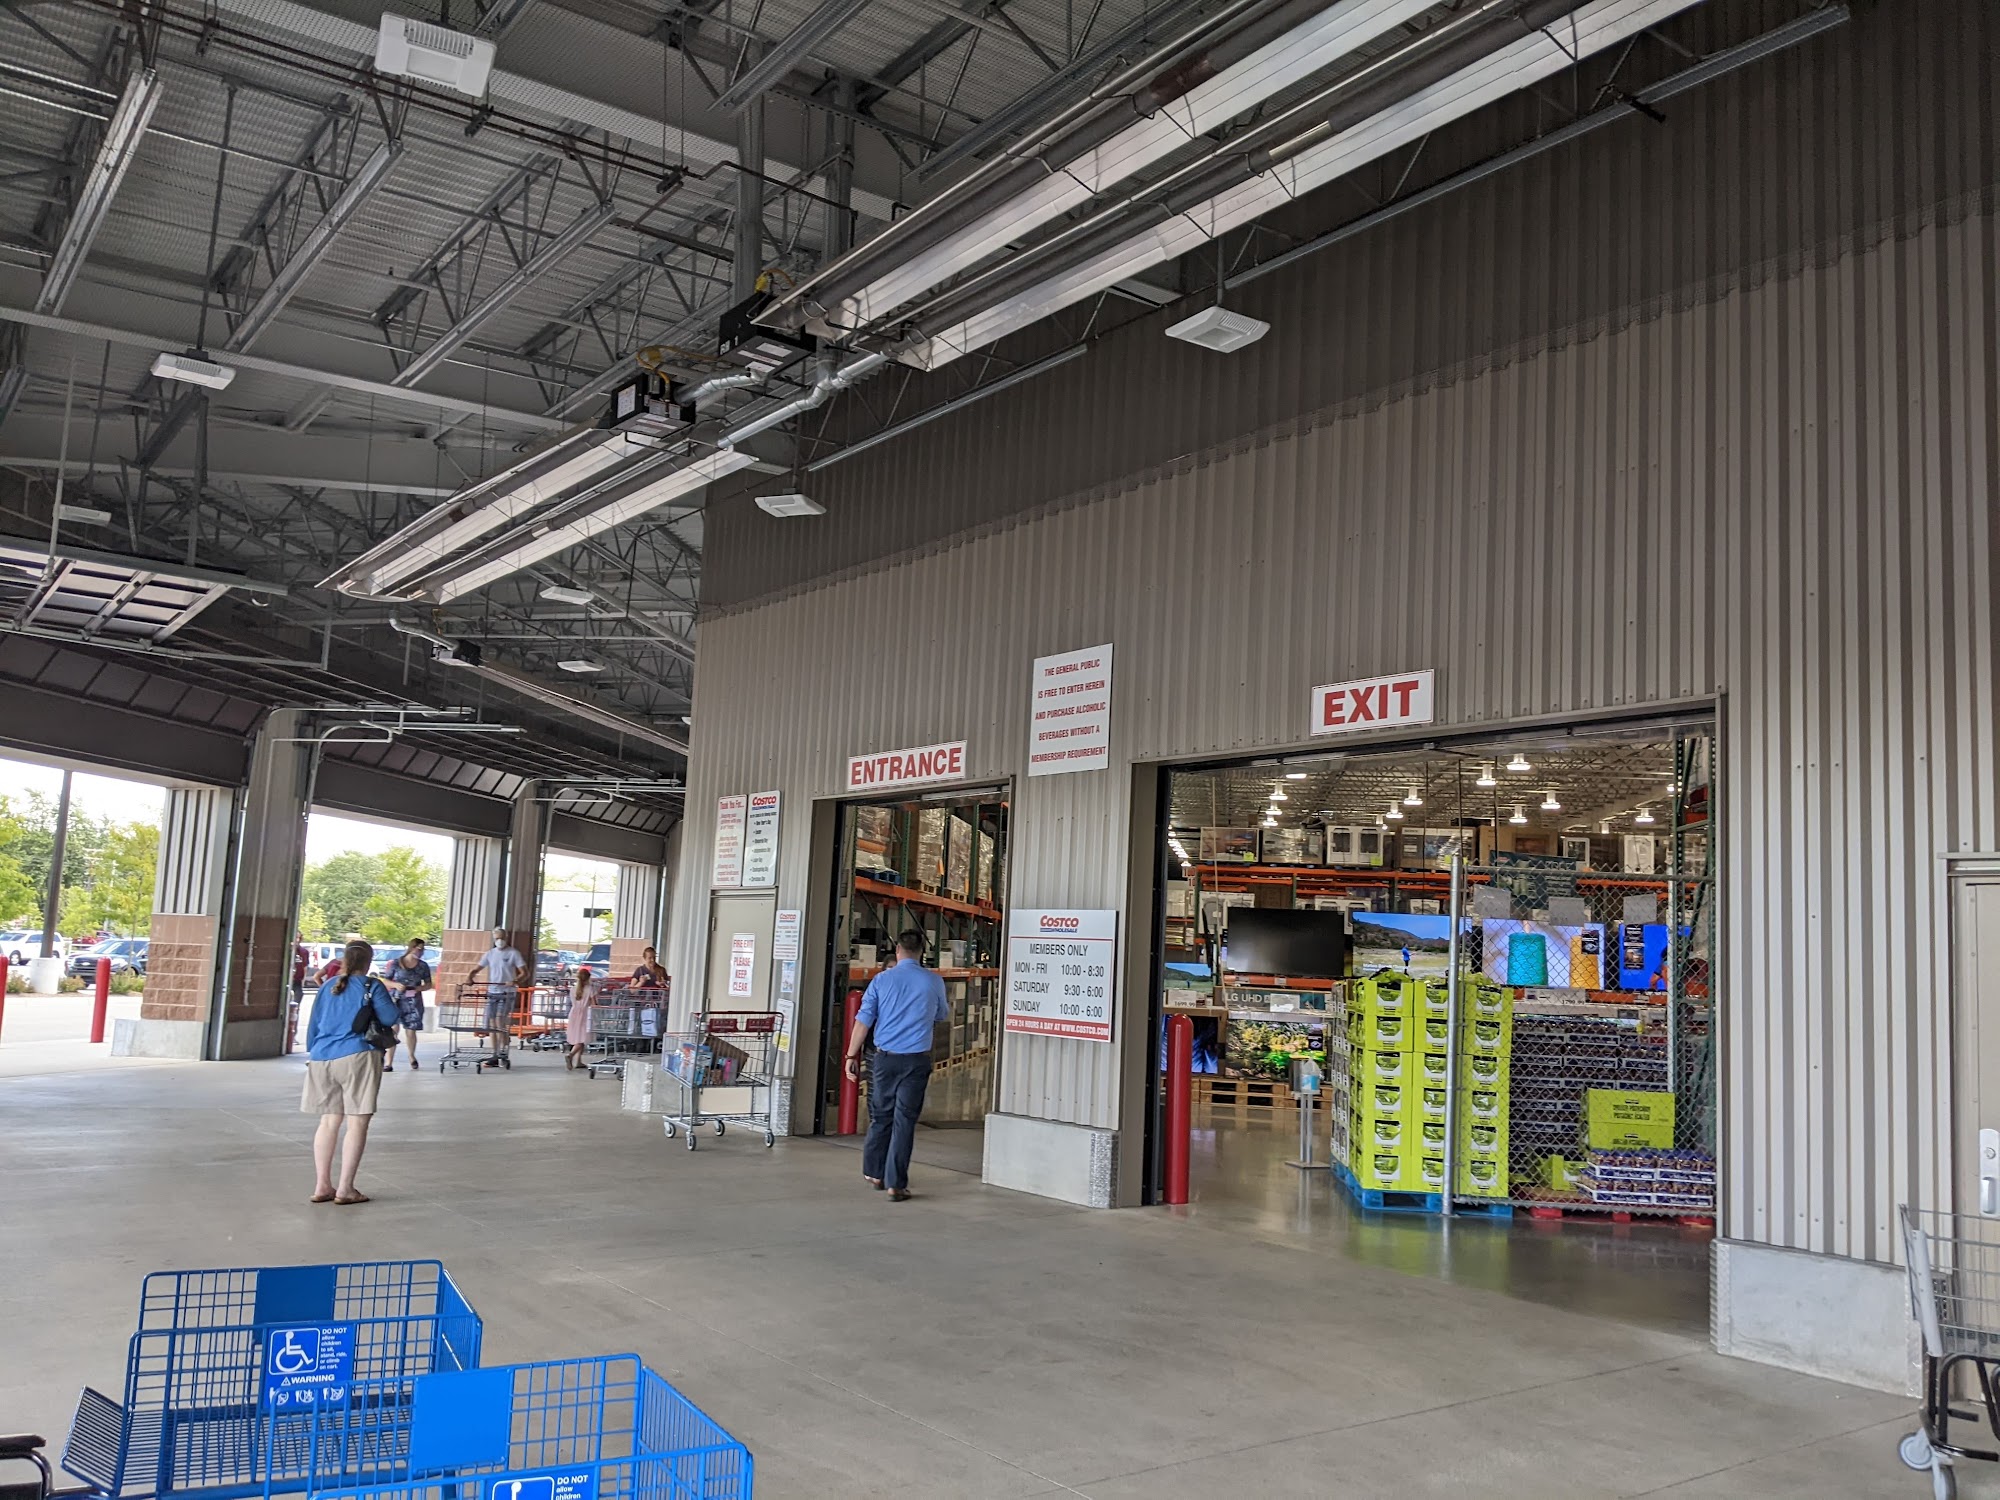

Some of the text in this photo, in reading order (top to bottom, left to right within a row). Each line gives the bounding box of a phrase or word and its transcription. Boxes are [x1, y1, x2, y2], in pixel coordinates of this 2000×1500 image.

[1045, 659, 1101, 677] THE GENERAL PUBLIC
[1038, 680, 1105, 699] IS FREE TO ENTER HEREIN
[1324, 680, 1419, 726] EXIT
[1035, 702, 1106, 721] AND PURCHASE ALCOHOLIC
[1038, 725, 1100, 741] BEVERAGES WITHOUT A
[1031, 746, 1107, 763] MEMBERSHIP REQUIREMENT
[851, 747, 962, 785] ENTRANCE
[752, 796, 777, 806] COSTCO
[1040, 915, 1079, 928] COSTCO
[1030, 943, 1088, 956] MEMBERS ONLY
[734, 957, 751, 966] PLEASE
[735, 969, 747, 978] KEEP
[1015, 962, 1030, 973] MON
[1036, 963, 1048, 974] FRI
[1061, 964, 1081, 976] 10:00
[1088, 966, 1104, 977] 8:30
[733, 982, 748, 991] CLEAR
[1013, 981, 1050, 994] SATURDAY
[1064, 984, 1080, 996] 9:30
[1087, 986, 1103, 998] 6:00
[1226, 993, 1238, 1001] LG
[1241, 993, 1262, 1003] UHD
[1013, 1000, 1041, 1012] SUNDAY
[1059, 1004, 1080, 1016] 10:00
[1086, 1006, 1103, 1017] 6:00
[1007, 1018, 1018, 1027] OPEN
[1025, 1020, 1039, 1029] HOURS
[1039, 1021, 1043, 1029] A
[1044, 1022, 1054, 1030] DAY
[1054, 1023, 1061, 1031] AT
[1061, 1024, 1109, 1036] WWW.COSTCO.COM
[291, 1374, 335, 1384] WARNING
[557, 1474, 588, 1485] DO NOT
